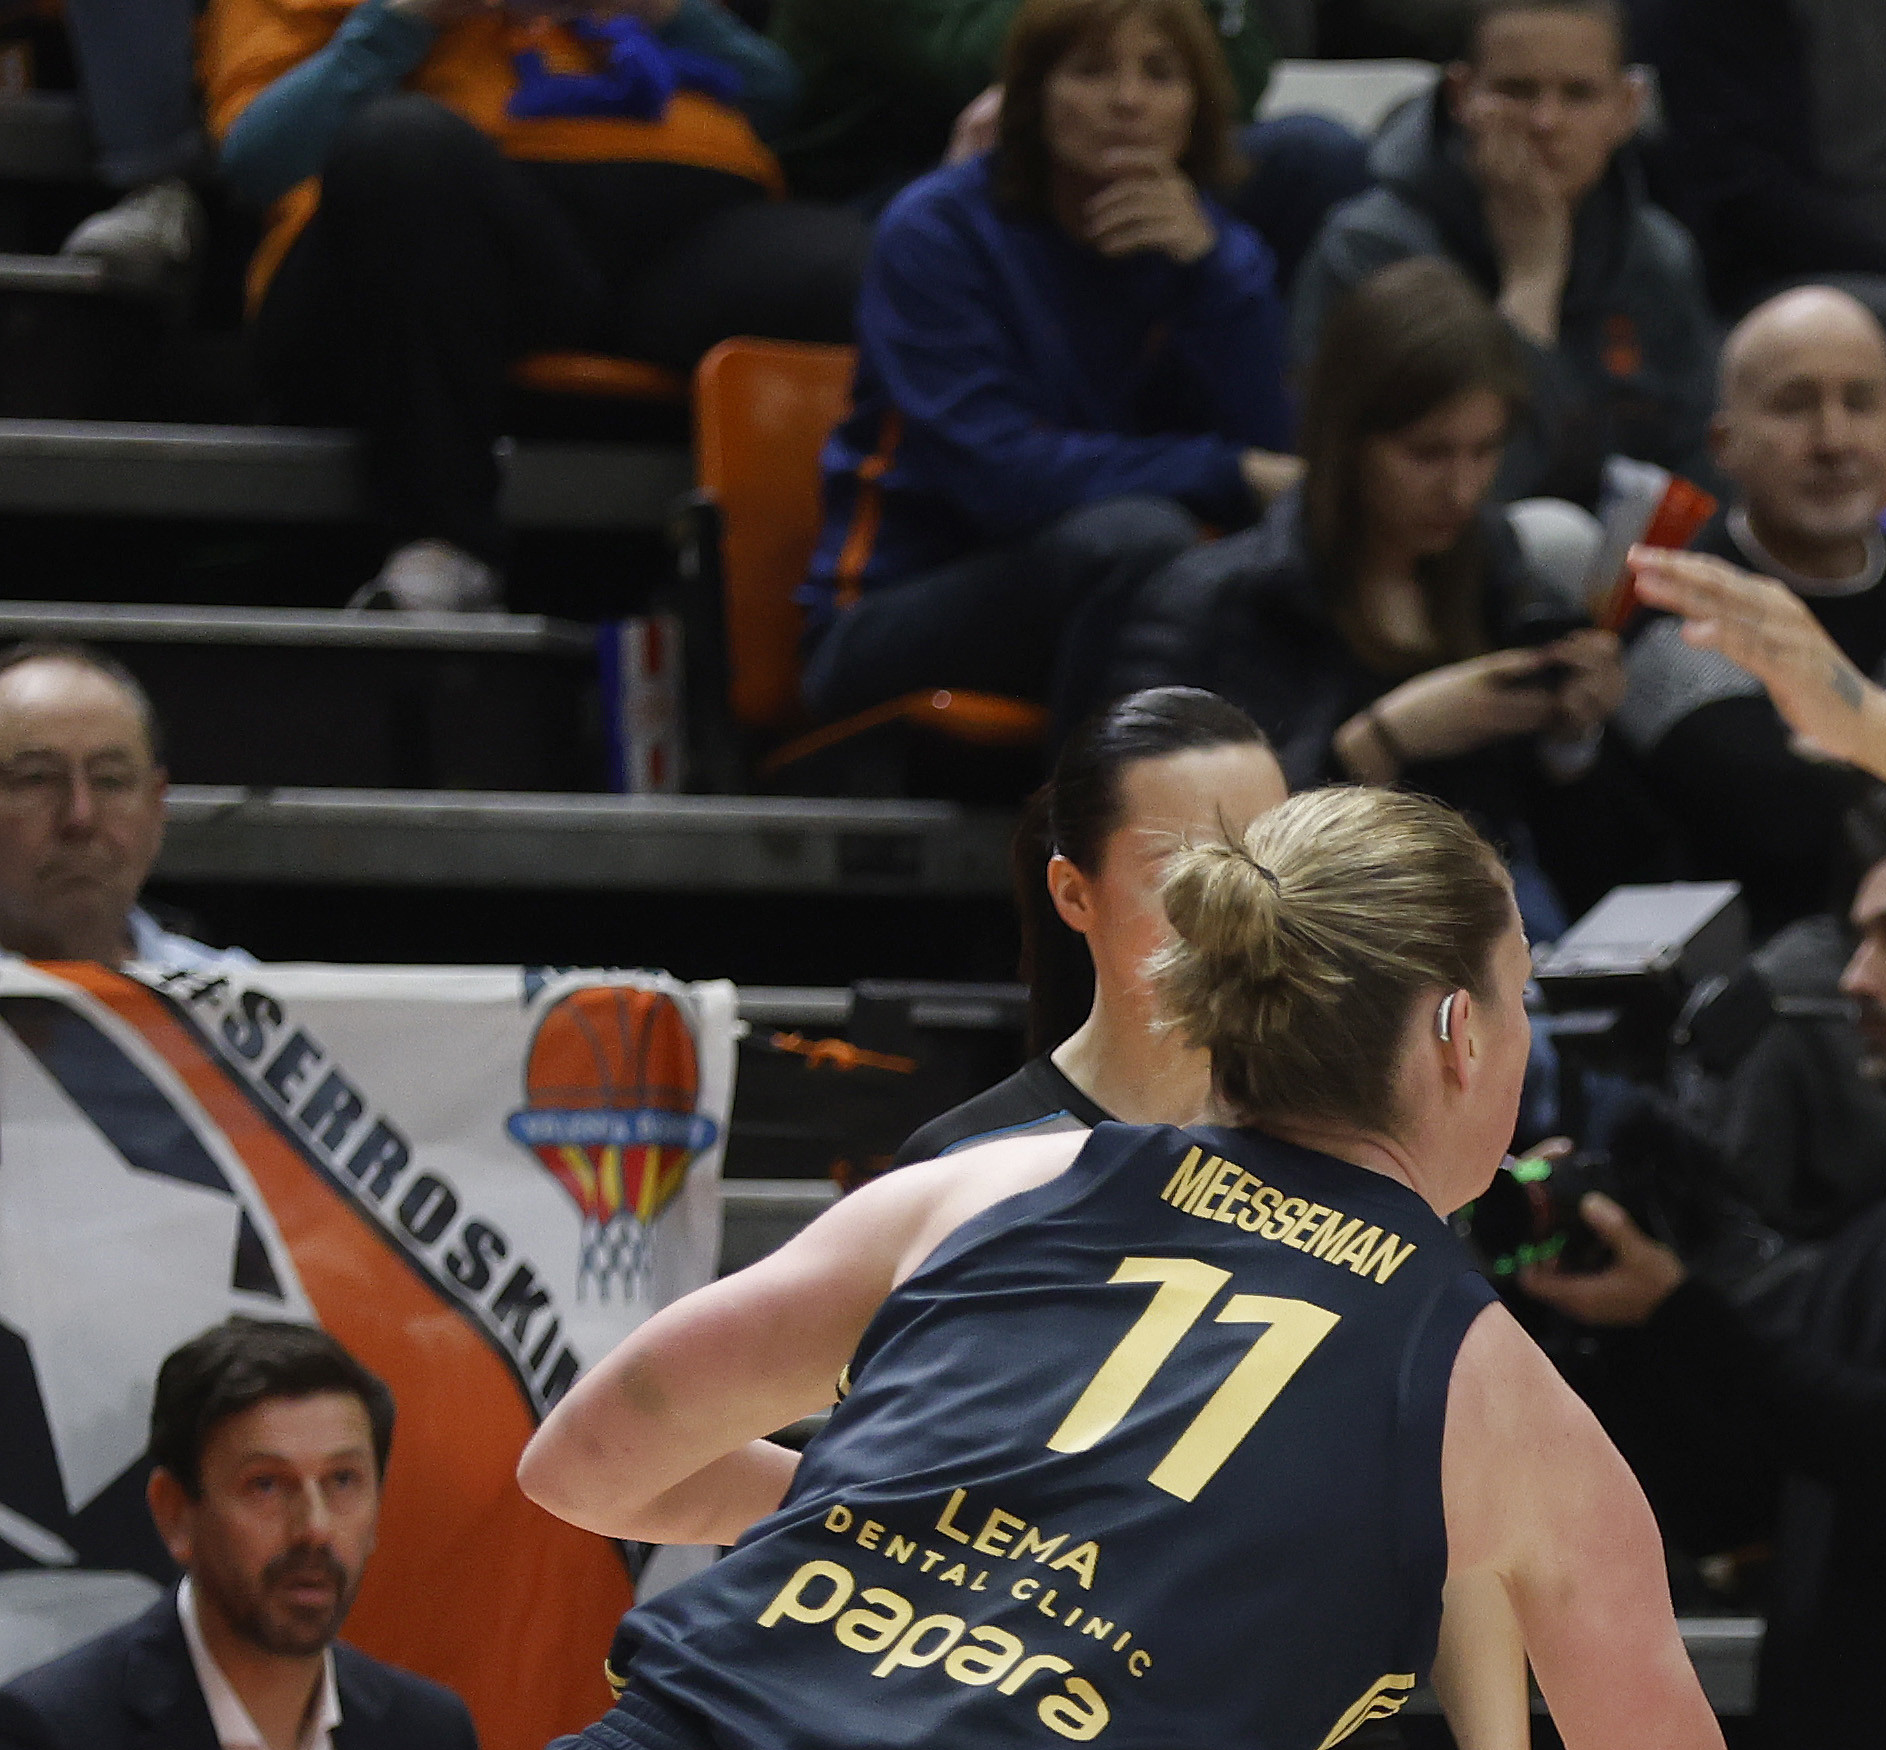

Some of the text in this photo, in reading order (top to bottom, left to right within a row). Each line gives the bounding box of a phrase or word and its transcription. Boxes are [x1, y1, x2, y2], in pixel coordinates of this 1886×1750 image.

[1161, 1145, 1416, 1286] MEESSEMAN
[1047, 1256, 1342, 1502] 11
[825, 1504, 1152, 1679] DENTAL CLINIC
[936, 1488, 1101, 1590] LEMA
[757, 1559, 1111, 1742] papara
